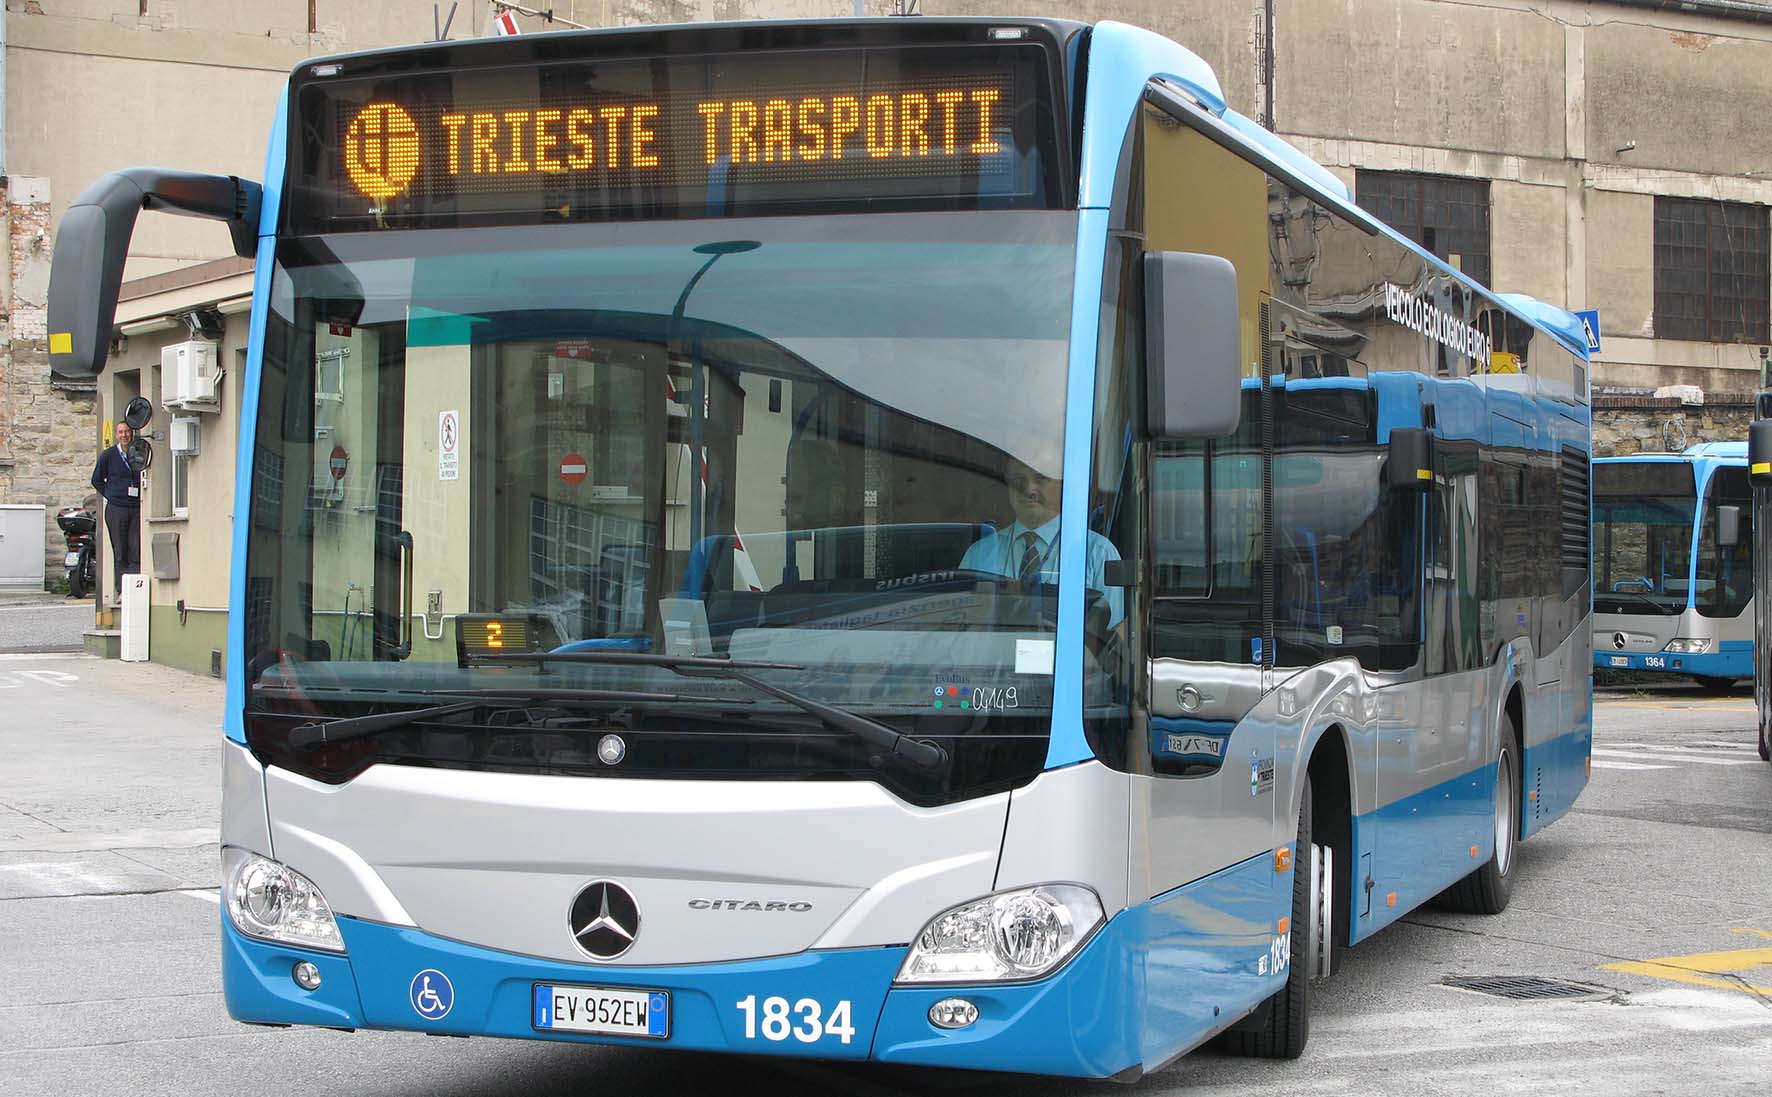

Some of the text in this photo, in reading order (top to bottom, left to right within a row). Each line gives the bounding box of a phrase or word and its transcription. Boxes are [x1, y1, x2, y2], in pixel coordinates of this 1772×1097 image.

[441, 89, 999, 175] TRIESTE TRASPORTI
[1384, 281, 1423, 333] VEICOLO
[1423, 301, 1467, 354] ECOLOGICO
[1466, 325, 1486, 362] EURO
[486, 621, 503, 649] 2
[1644, 656, 1665, 668] 1364
[688, 899, 813, 912] CITARO
[1271, 931, 1291, 975] 1834
[554, 995, 578, 1022] EV
[585, 997, 648, 1027] 952EW
[735, 995, 856, 1044] 1834
